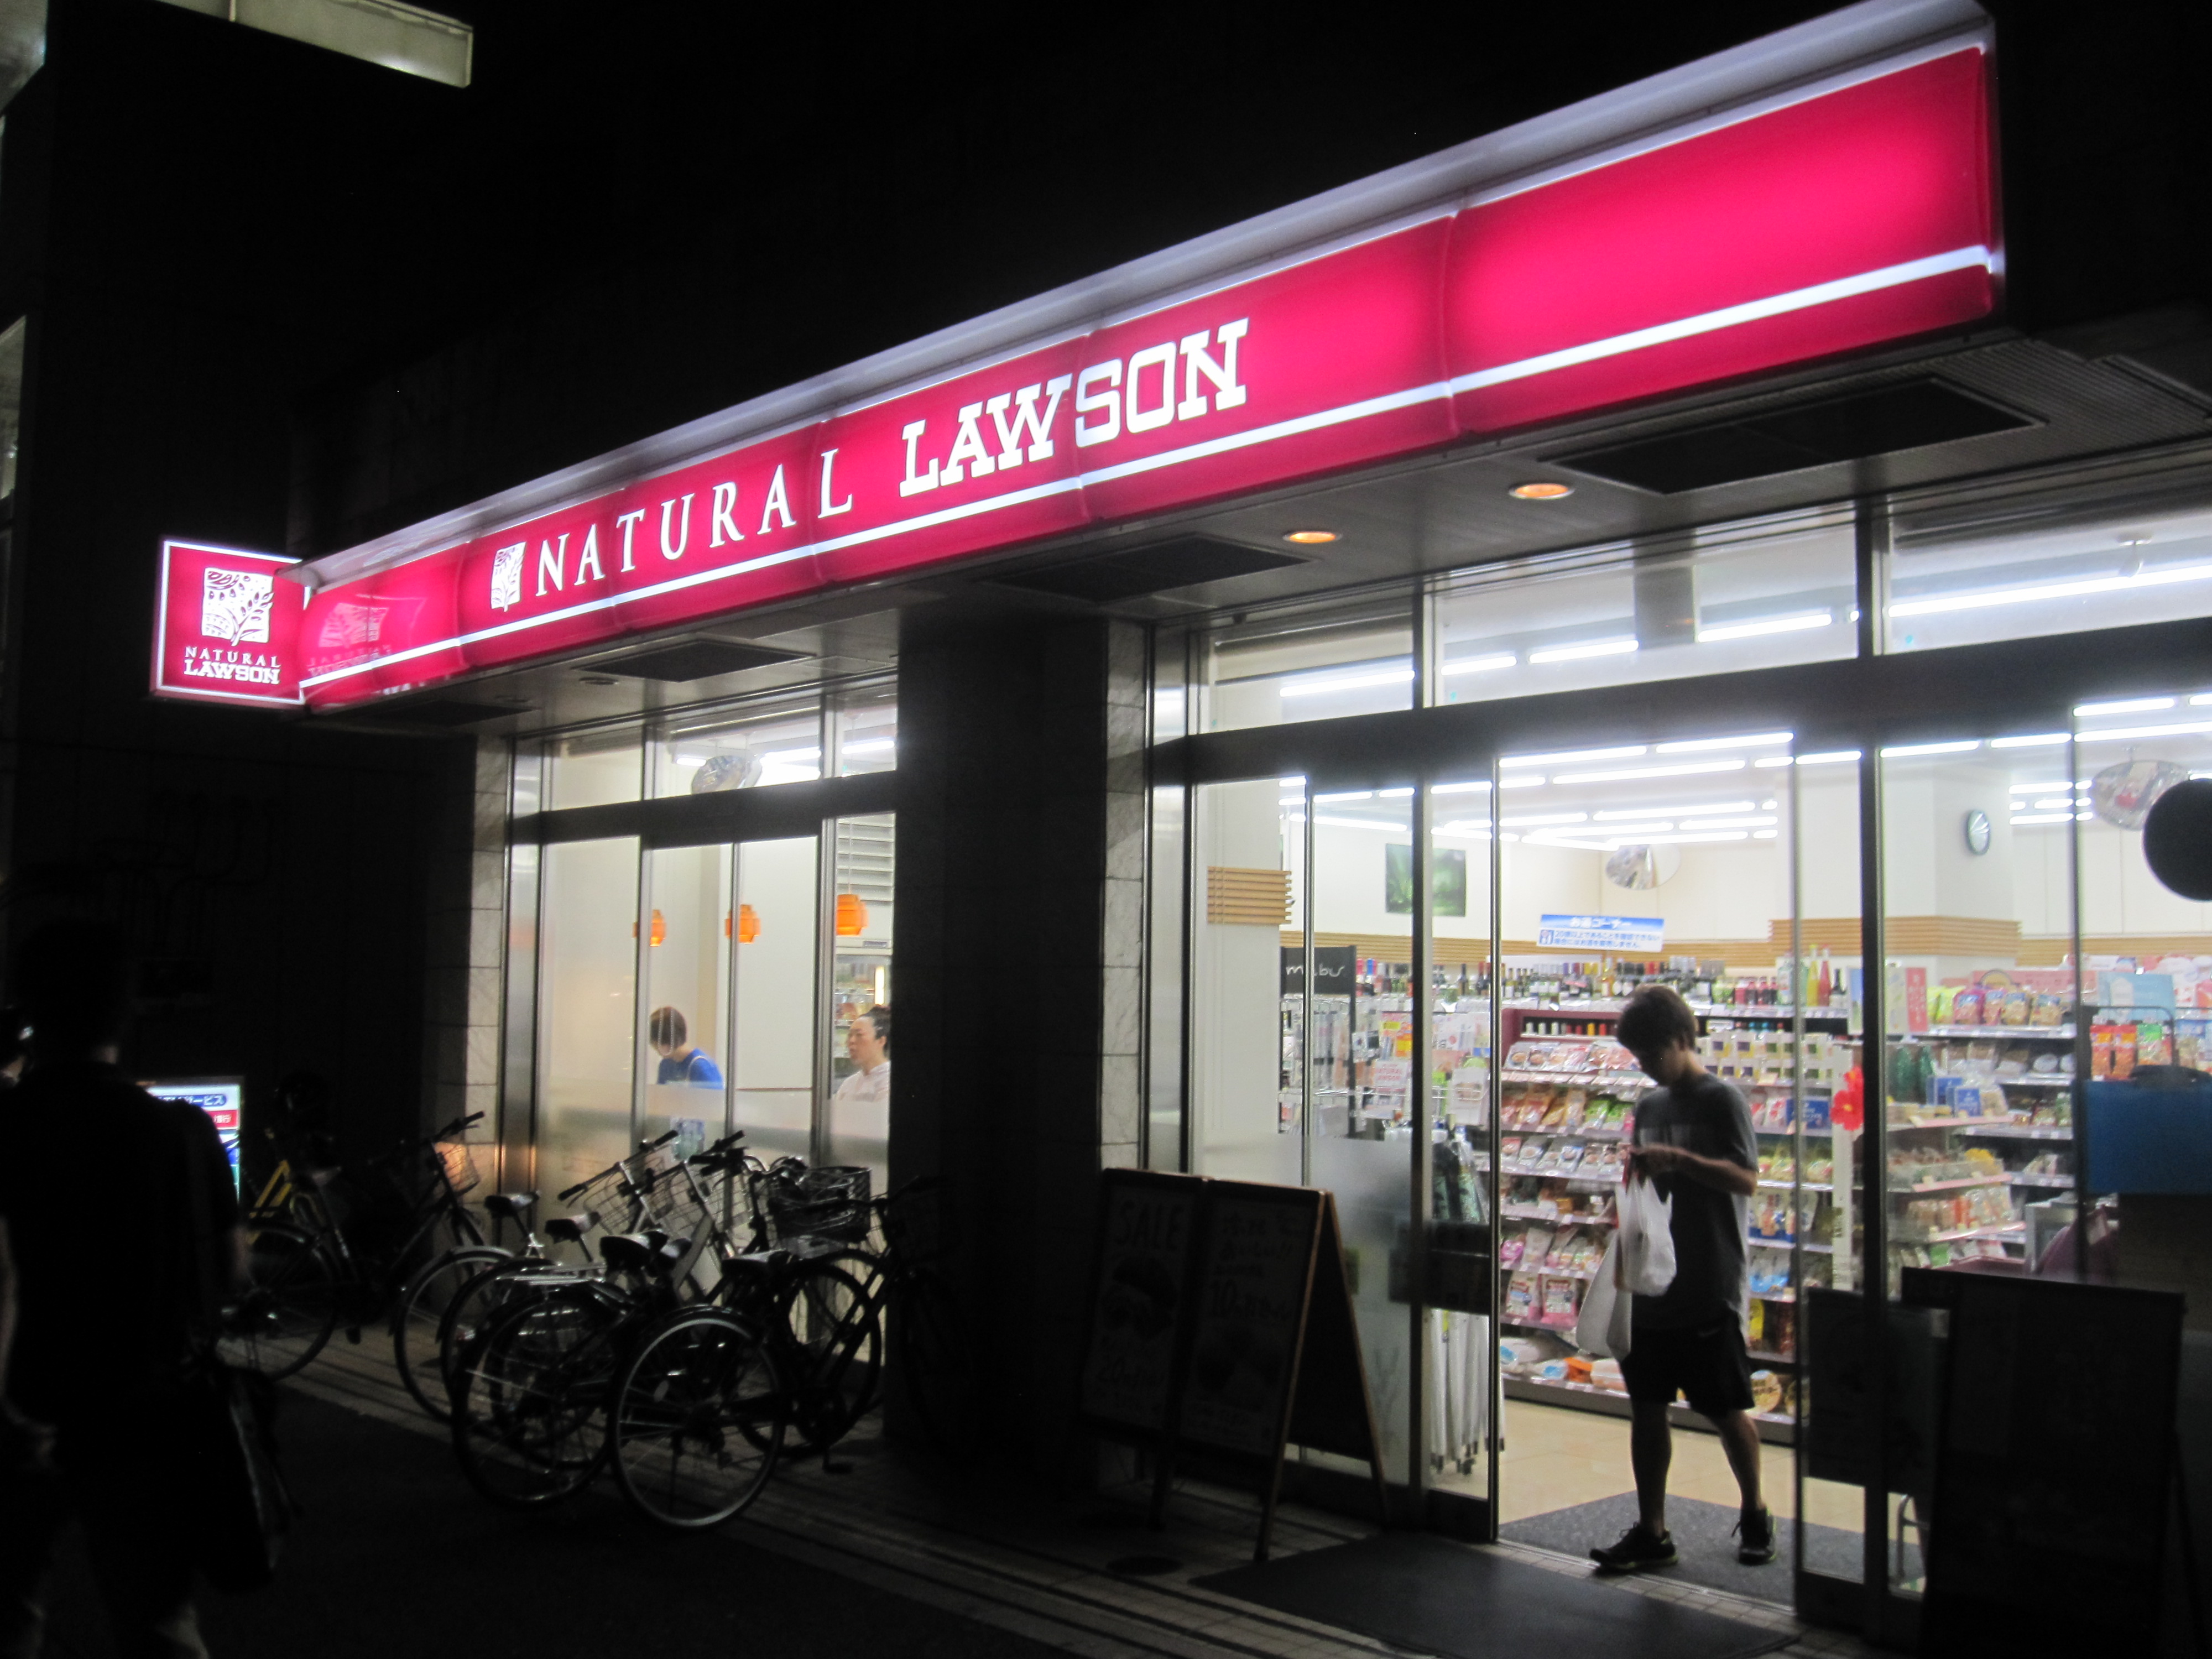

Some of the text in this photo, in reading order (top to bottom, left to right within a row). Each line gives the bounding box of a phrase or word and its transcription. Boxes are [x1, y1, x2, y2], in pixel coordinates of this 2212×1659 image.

[535, 316, 1250, 597] NATURAL LAWSON
[184, 645, 281, 668] NATURAL
[183, 659, 280, 685] LAWSON
[1285, 962, 1345, 978] mbu
